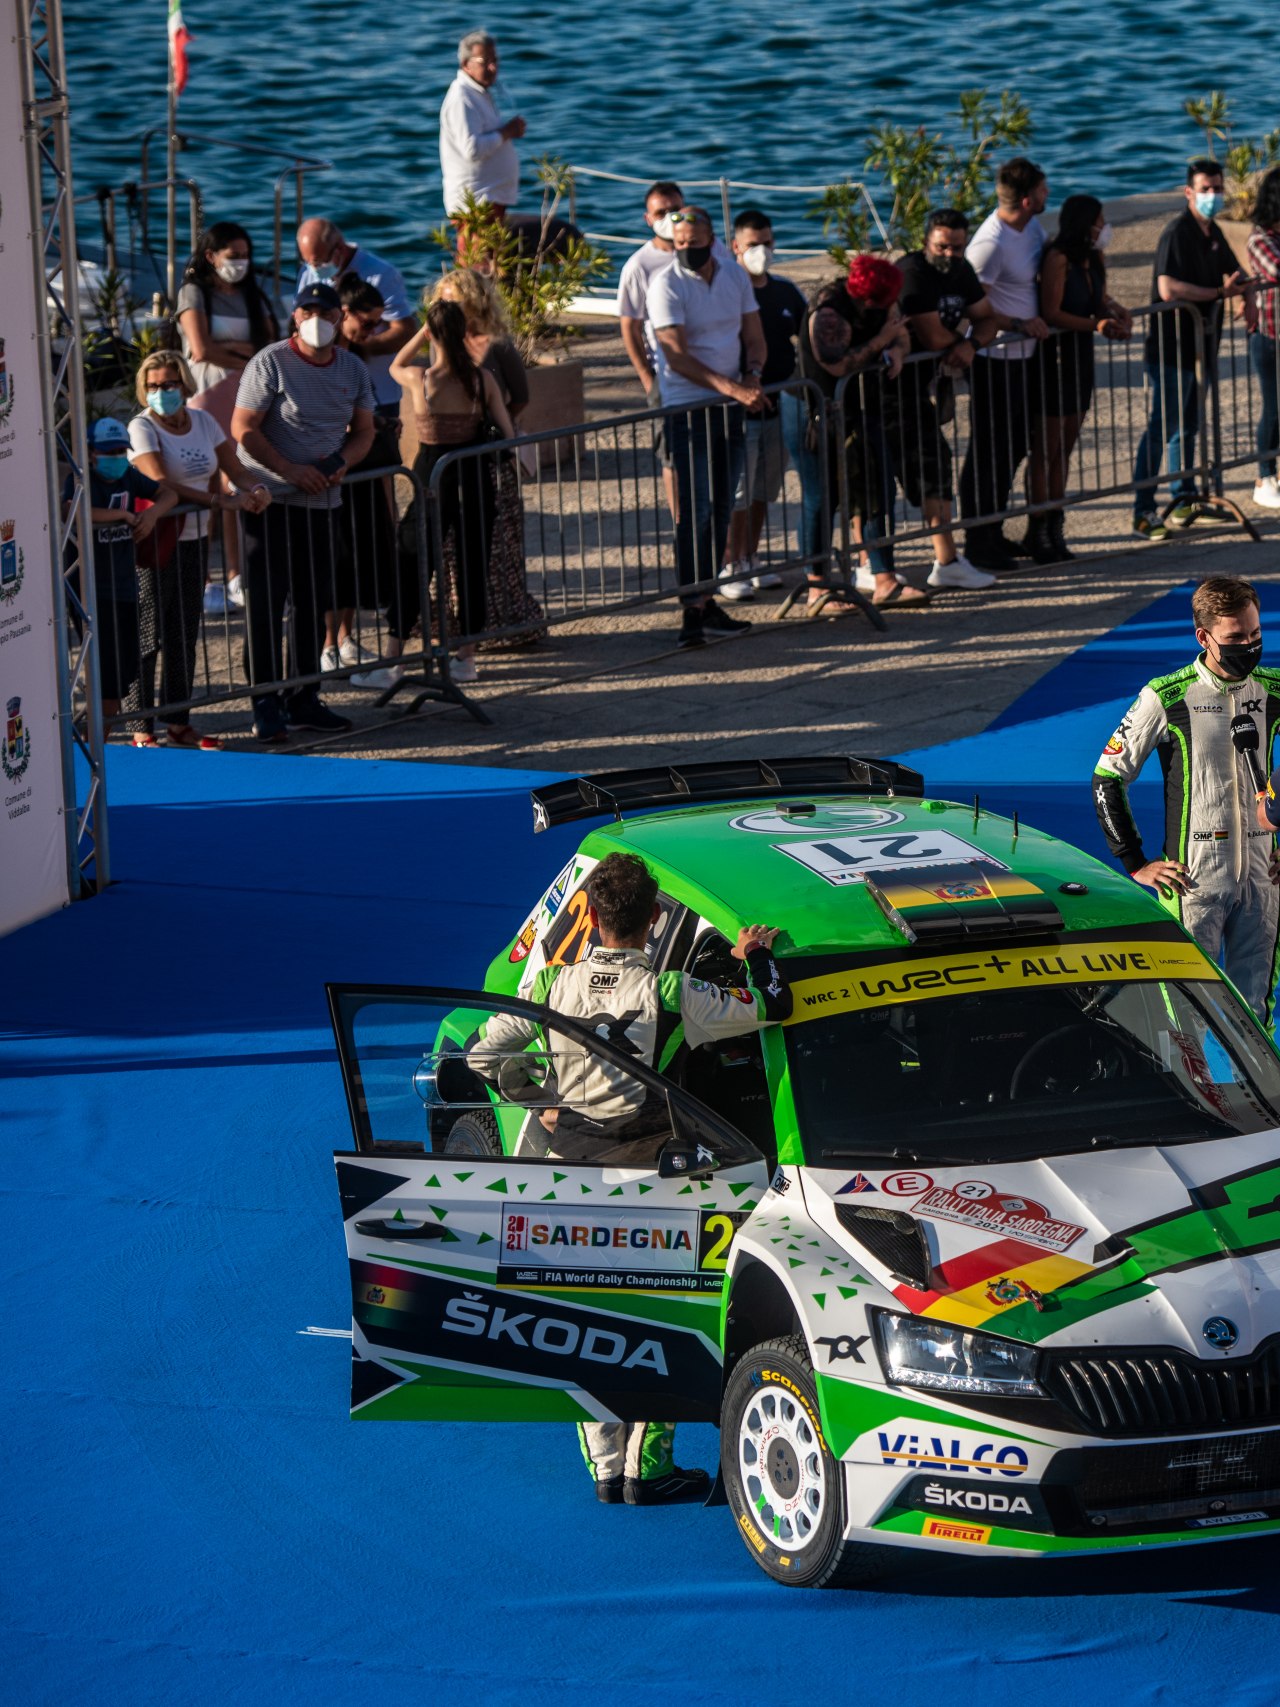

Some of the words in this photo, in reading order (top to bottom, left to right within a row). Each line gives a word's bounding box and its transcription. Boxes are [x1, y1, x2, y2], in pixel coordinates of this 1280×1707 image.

[1164, 687, 1182, 699] OMP
[1192, 832, 1213, 841] OMP
[591, 975, 619, 987] OMP
[803, 989, 839, 1008] WRC
[839, 988, 852, 999] 2
[1020, 956, 1078, 978] ALL
[1082, 951, 1152, 973] LIVE
[897, 1176, 919, 1192] E
[960, 1185, 988, 1198] 21
[926, 1190, 969, 1211] RALLY
[965, 1202, 1005, 1224] ITALIA
[1004, 1214, 1077, 1243] SARDEGNA
[974, 1220, 1005, 1233] 2021
[531, 1223, 693, 1251] SARDEGNA
[701, 1213, 734, 1270] 2
[545, 1272, 562, 1282] FIA
[565, 1273, 595, 1284] World
[597, 1275, 624, 1286] Rally
[626, 1275, 698, 1289] Championship
[704, 1280, 726, 1288] WRC
[441, 1290, 670, 1377] ŠKODA
[761, 1369, 829, 1458] SCORPION
[924, 1482, 1034, 1515] ŠKODA
[929, 1521, 985, 1541] PIRELLI
